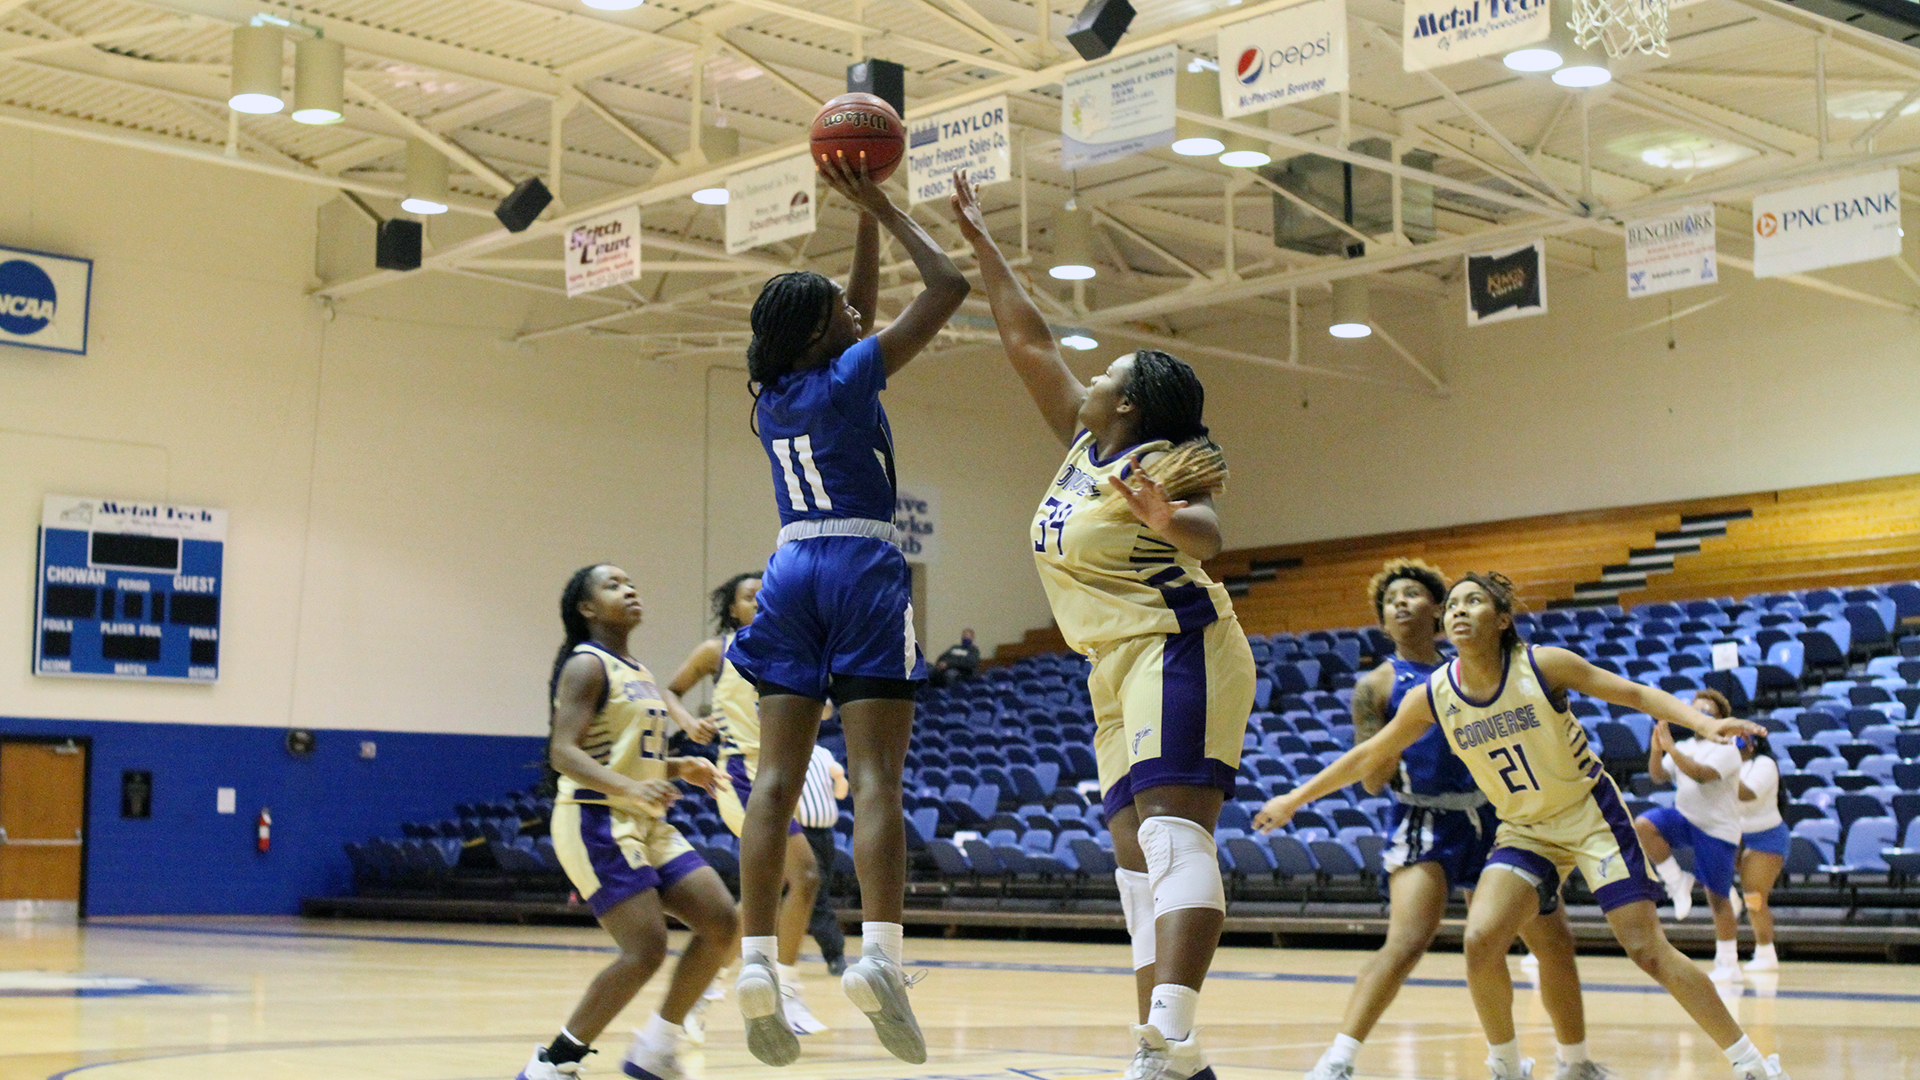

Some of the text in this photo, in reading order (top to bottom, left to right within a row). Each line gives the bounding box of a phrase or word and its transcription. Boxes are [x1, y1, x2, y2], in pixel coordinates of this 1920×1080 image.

[1413, 1, 1479, 38] Metal
[1269, 32, 1331, 73] pepsi
[1287, 78, 1326, 95] Beverage
[823, 111, 888, 131] Wilson
[942, 108, 1004, 139] TAYLOR
[909, 154, 934, 175] Taylor
[936, 145, 967, 165] Freezer
[968, 137, 991, 156] Sales
[1782, 191, 1898, 231] PNC BANK
[1628, 214, 1712, 243] BENCHMARK
[0, 293, 56, 320] NCAA
[772, 434, 833, 512] 11
[99, 502, 213, 522] Metal Tech
[1035, 496, 1073, 555] 34
[47, 565, 106, 585] CHOWAN
[117, 578, 151, 592] PERIOD
[173, 574, 215, 593] GUEST
[43, 618, 73, 632] FOULS
[101, 622, 162, 638] PLAYER FOUL
[189, 627, 218, 640] FOULS
[1453, 704, 1541, 750] CONVERSE
[1488, 743, 1540, 794] 21
